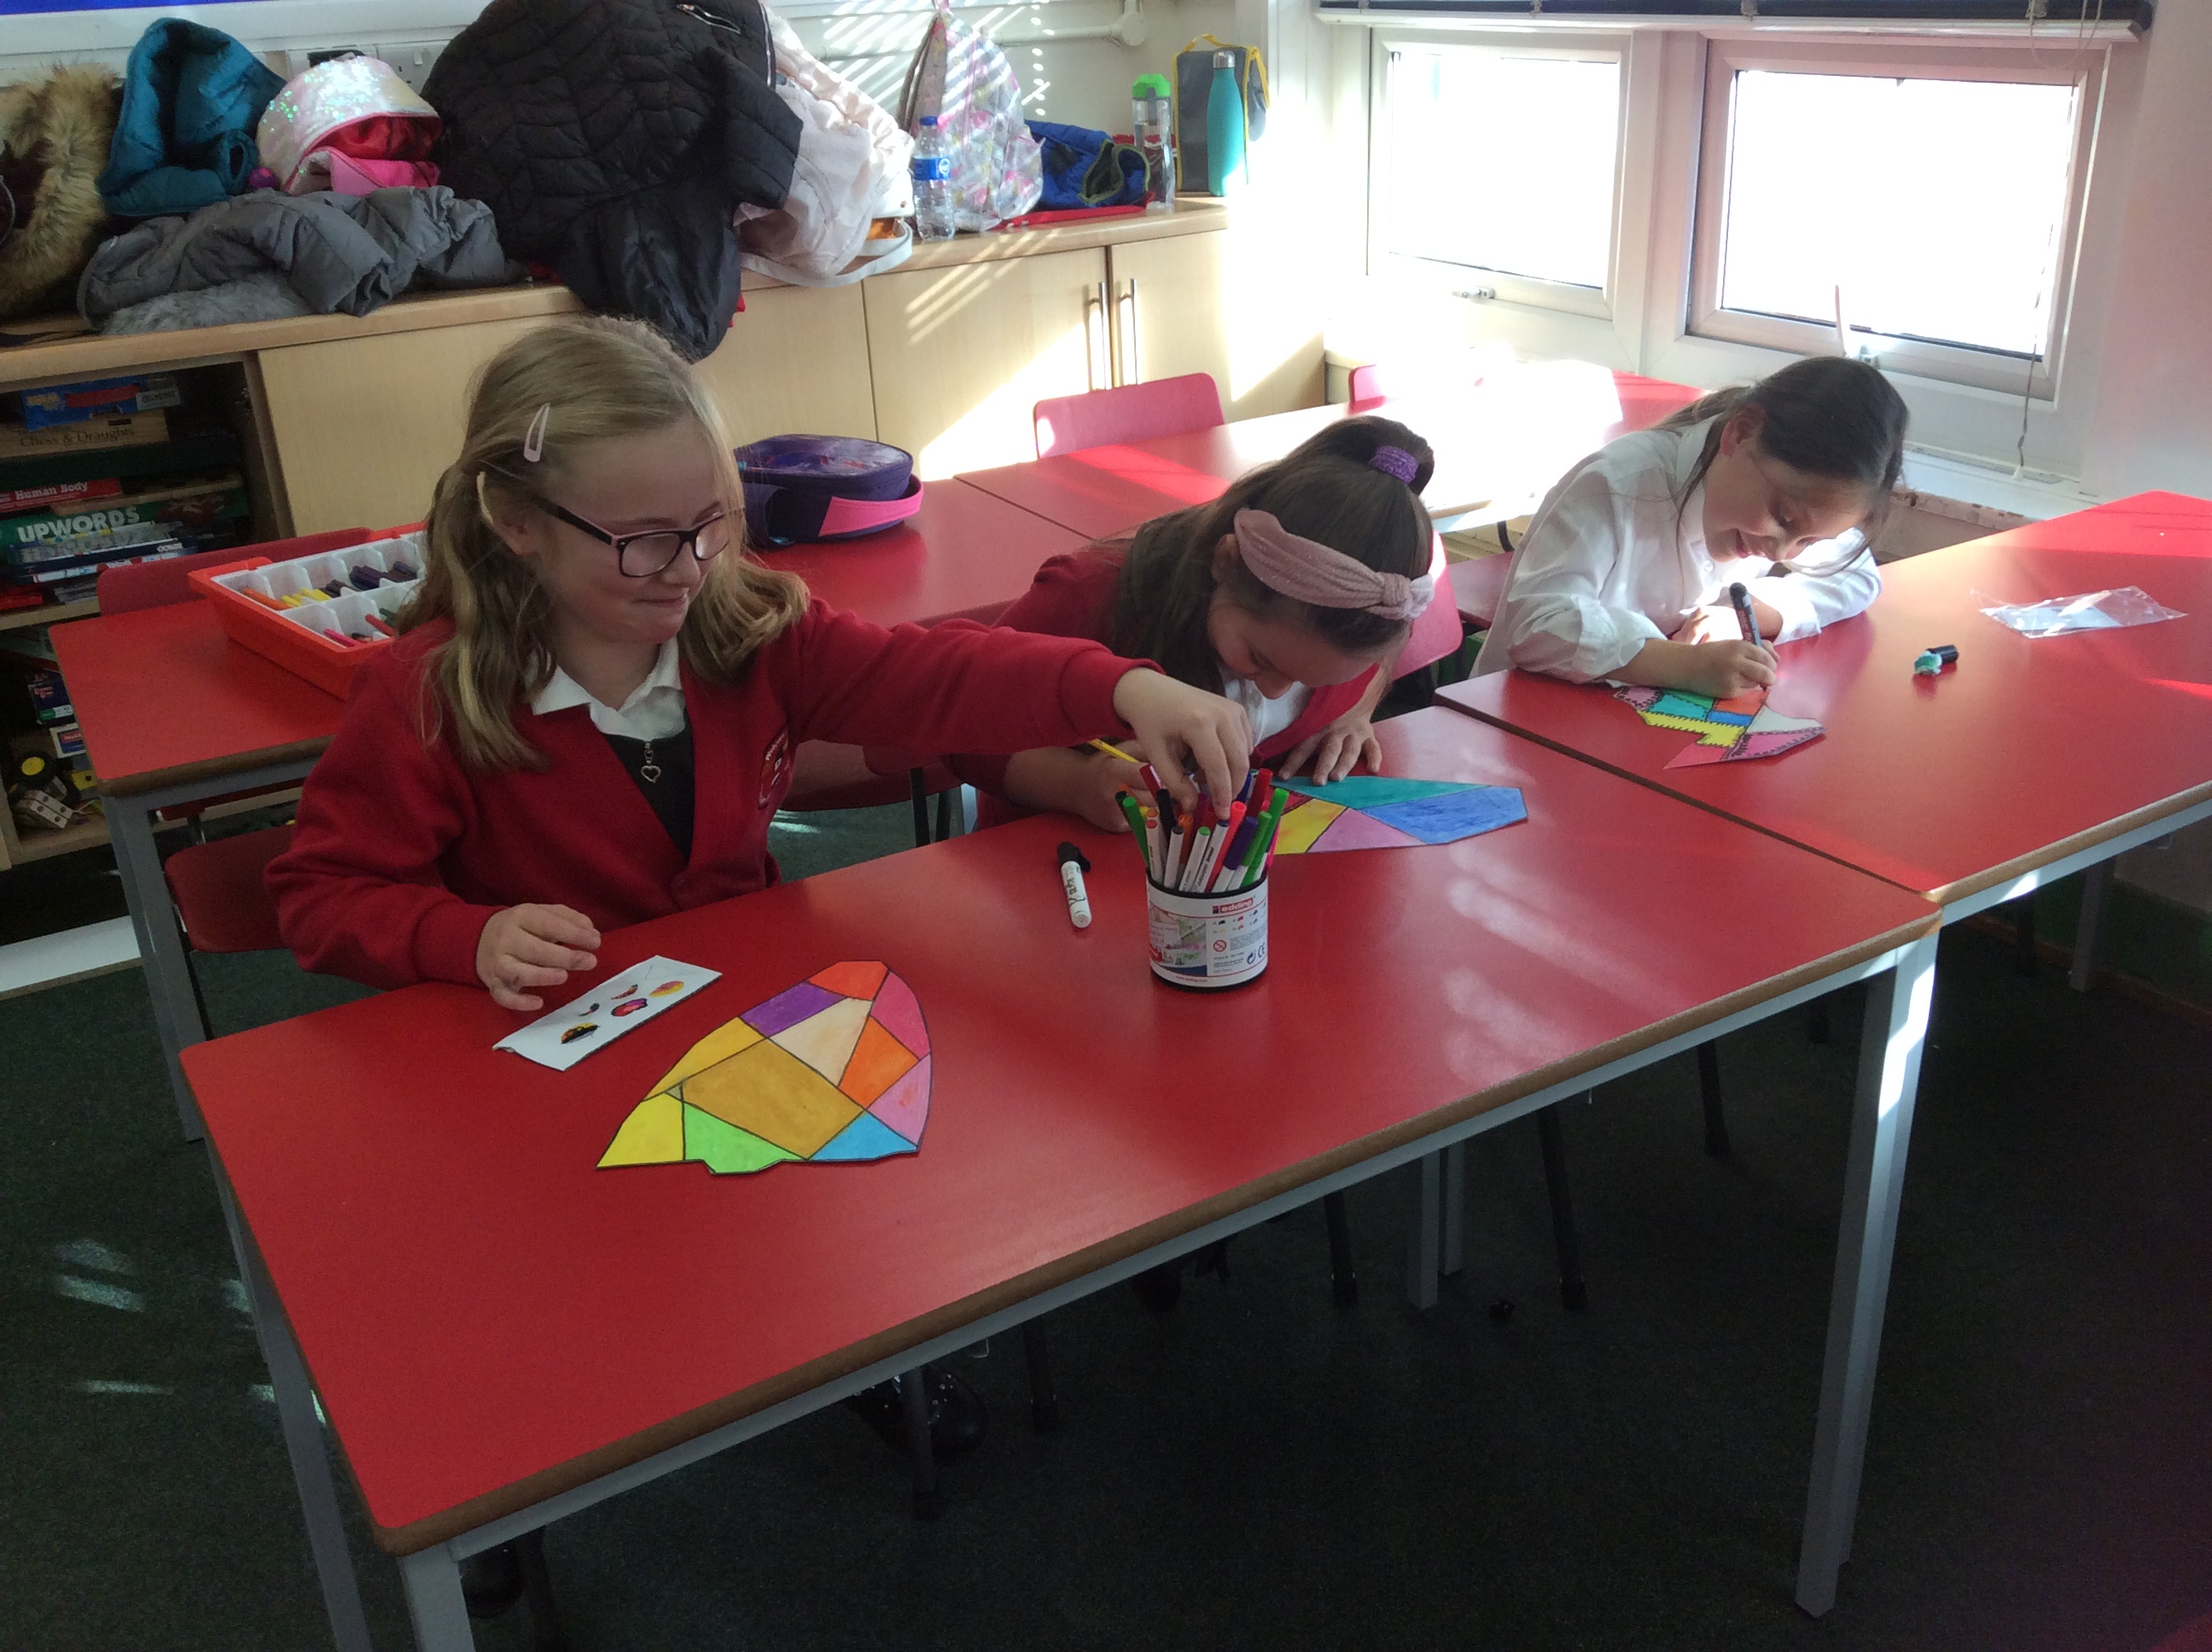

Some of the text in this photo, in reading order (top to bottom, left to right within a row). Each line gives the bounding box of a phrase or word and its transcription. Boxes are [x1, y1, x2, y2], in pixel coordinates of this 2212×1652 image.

[20, 427, 135, 447] Chess & Draughts
[15, 486, 57, 500] Human
[61, 481, 88, 494] Body
[18, 507, 139, 542] UPWORDS
[1221, 899, 1252, 912] edding
